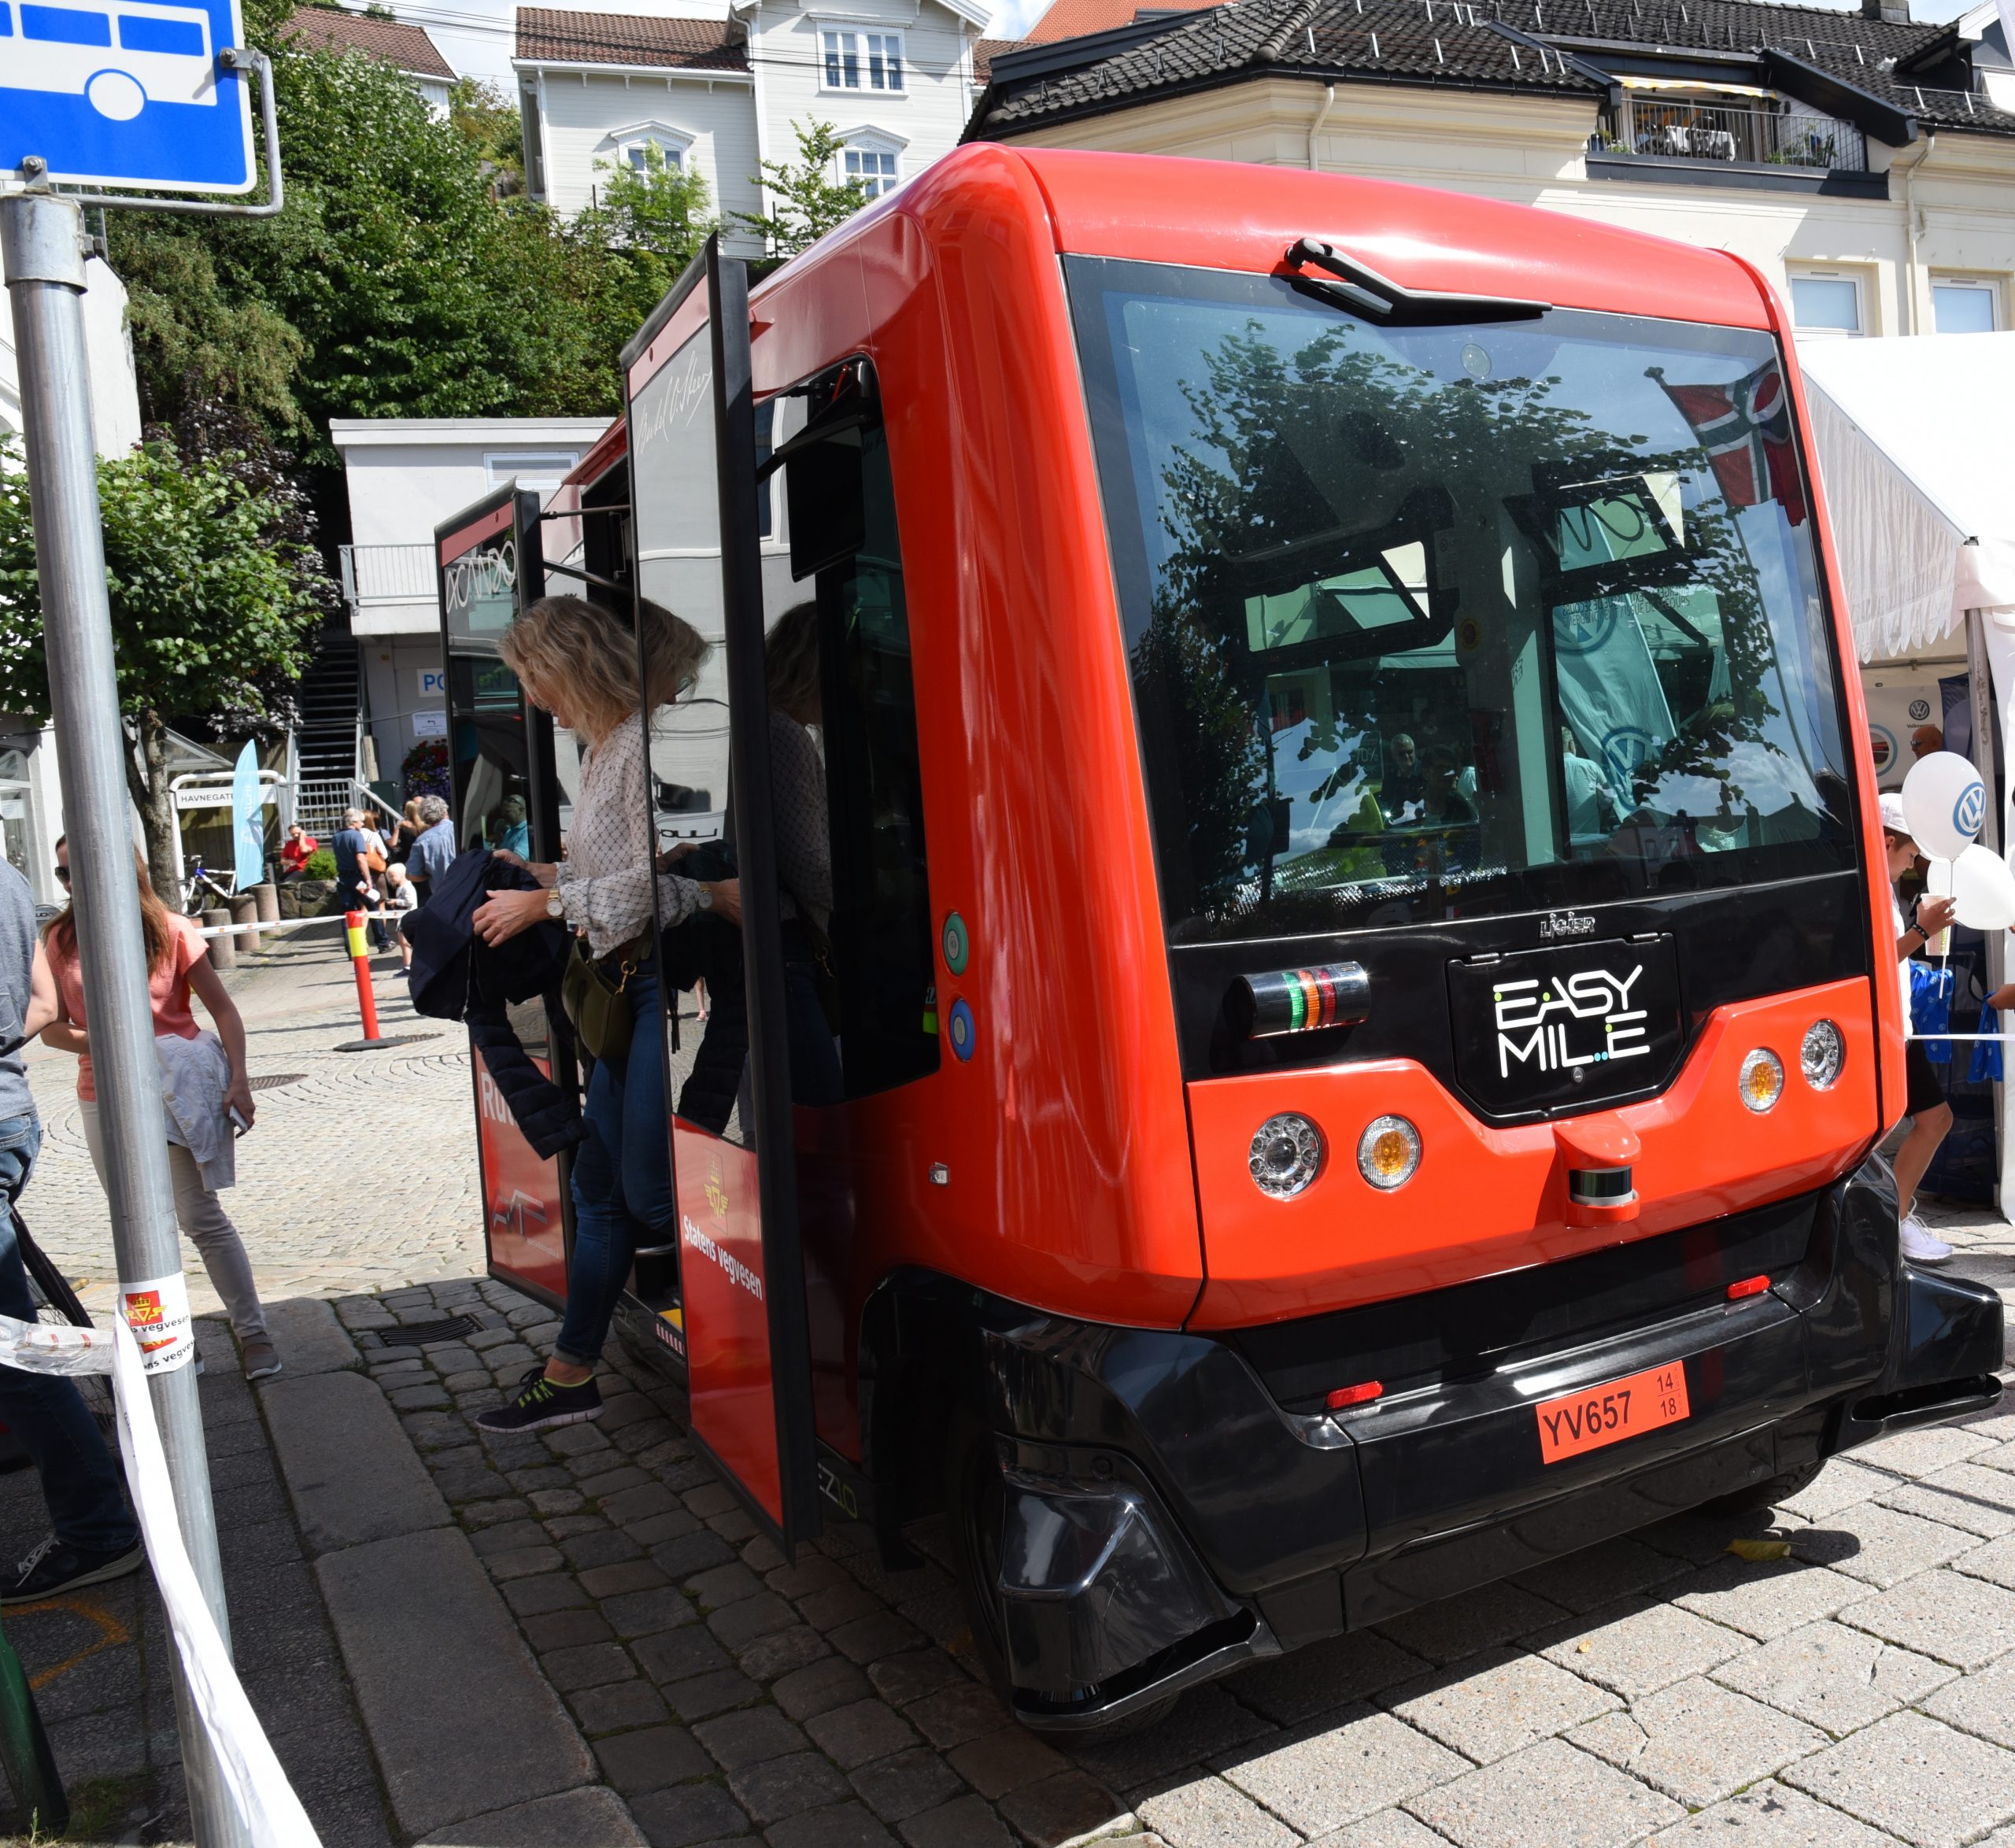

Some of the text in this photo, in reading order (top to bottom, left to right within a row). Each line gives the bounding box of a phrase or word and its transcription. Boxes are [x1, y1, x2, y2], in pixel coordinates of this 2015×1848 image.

[1493, 964, 1643, 1030] EASY
[1498, 1010, 1651, 1078] MILE
[683, 1214, 763, 1300] Statens vegvesen
[162, 1340, 195, 1363] vegves
[1657, 1372, 1673, 1392] 14
[1661, 1398, 1677, 1417] 18
[1543, 1390, 1632, 1447] YV657
